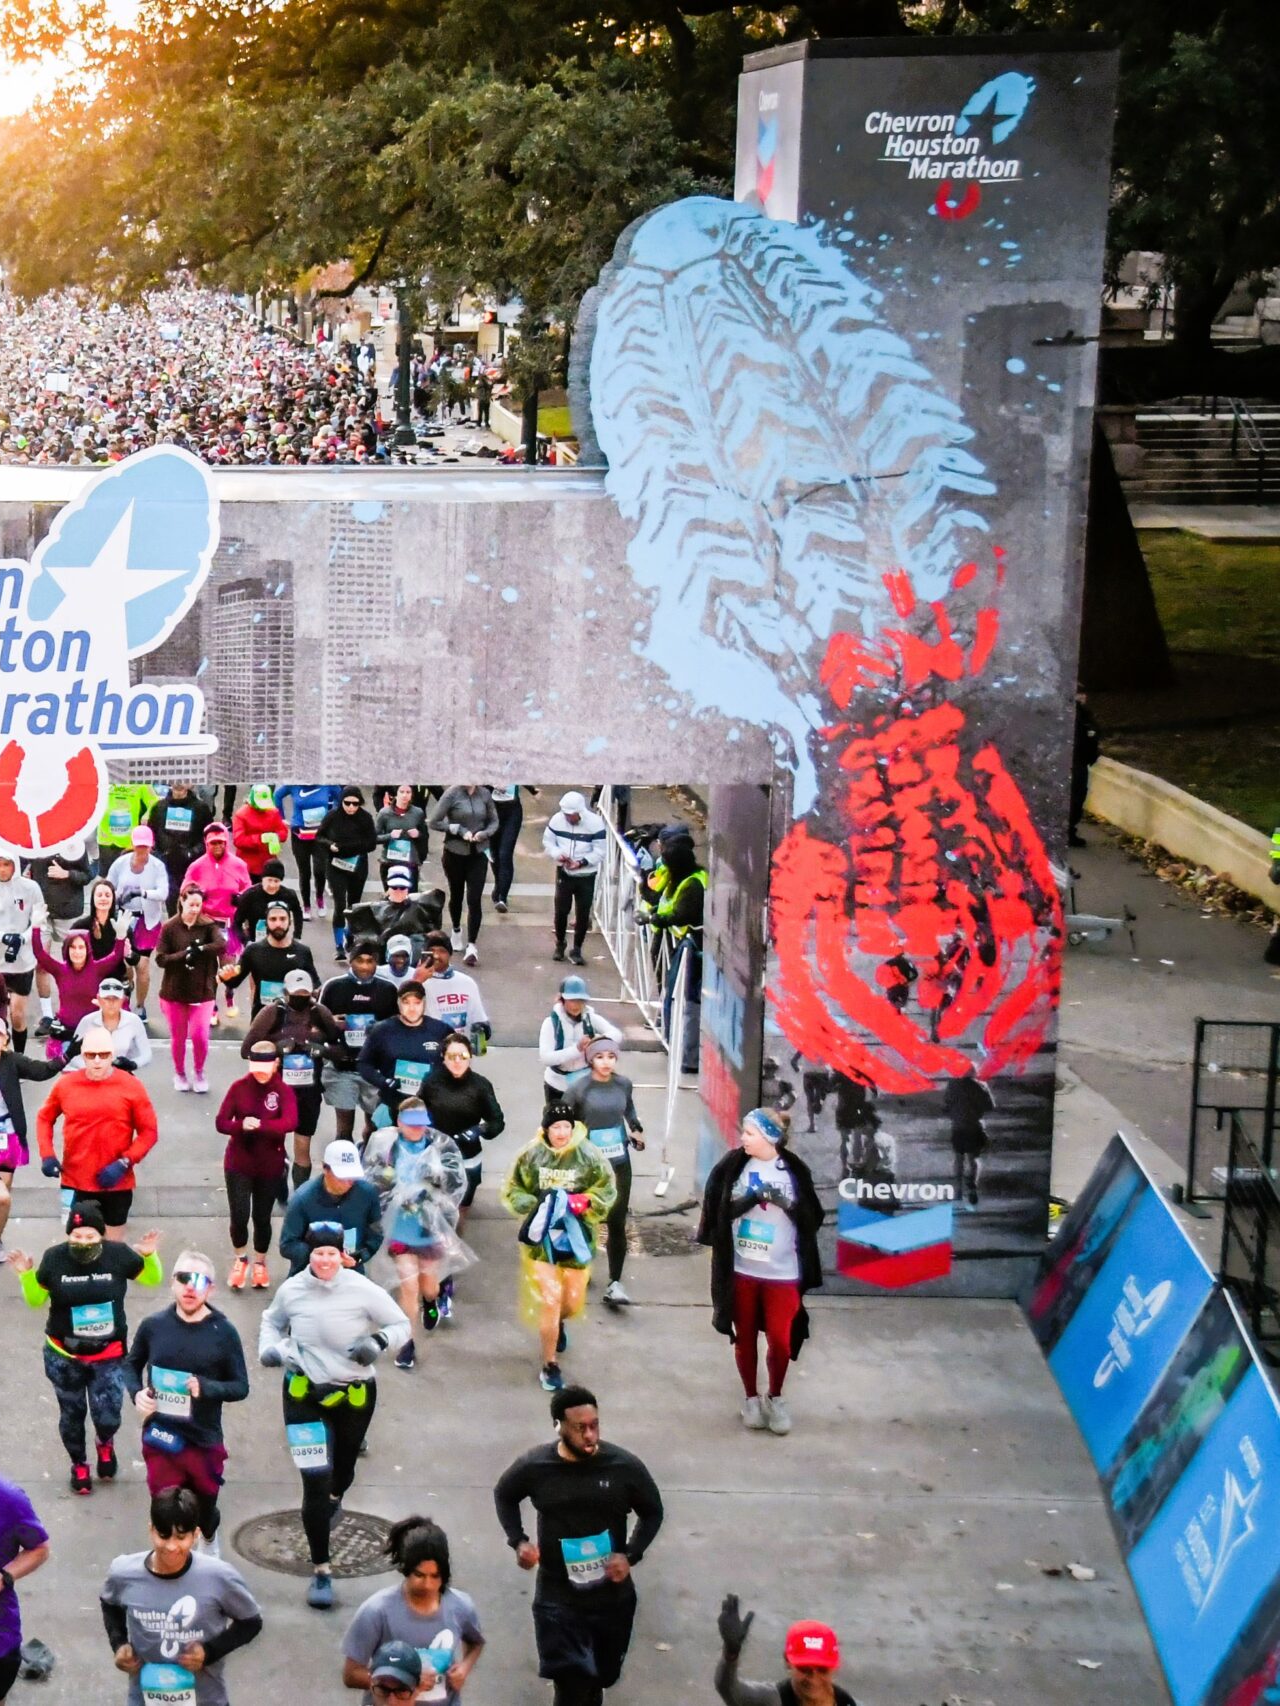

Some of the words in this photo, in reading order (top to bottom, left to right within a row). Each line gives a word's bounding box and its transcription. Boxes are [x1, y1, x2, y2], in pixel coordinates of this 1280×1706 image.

[865, 112, 956, 135] Chevron
[884, 134, 980, 157] Houston
[907, 157, 1020, 180] Marathon
[838, 1177, 955, 1201] Chevron
[61, 1273, 89, 1284] Forever
[91, 1271, 113, 1282] Young
